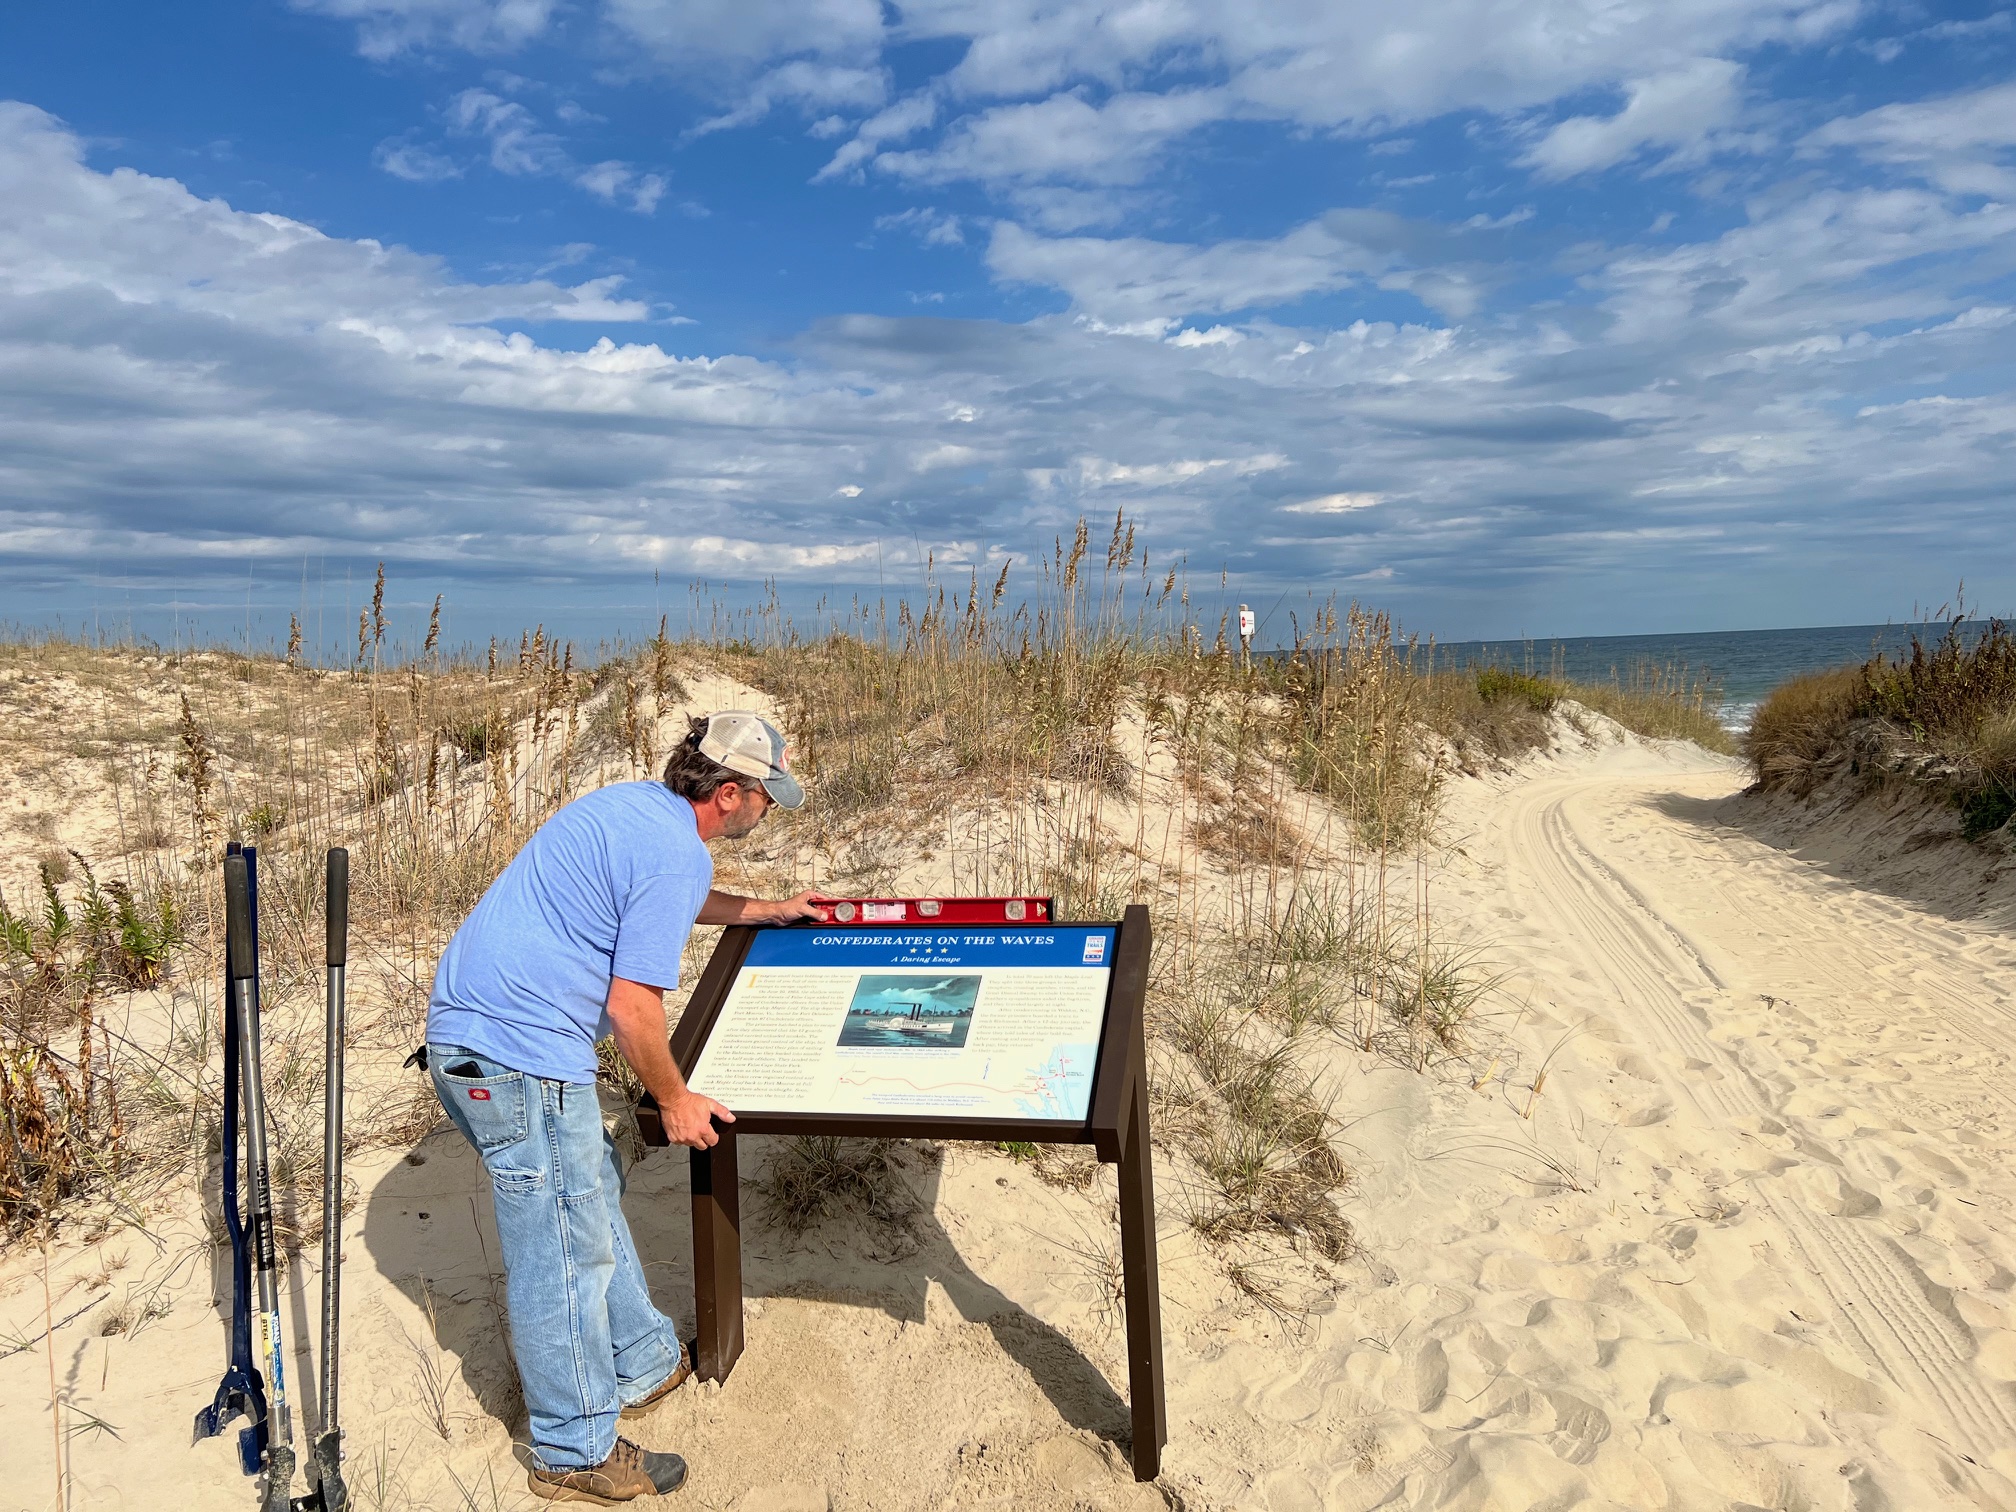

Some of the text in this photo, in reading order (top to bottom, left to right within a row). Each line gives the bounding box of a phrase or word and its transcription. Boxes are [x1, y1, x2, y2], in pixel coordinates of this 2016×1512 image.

[812, 936, 1055, 945] CONFEDERATES ON THE WAVES
[900, 956, 930, 964] Daring
[932, 956, 961, 964] Escape
[255, 1160, 269, 1208] KOBALT
[260, 1220, 273, 1263] STEEL
